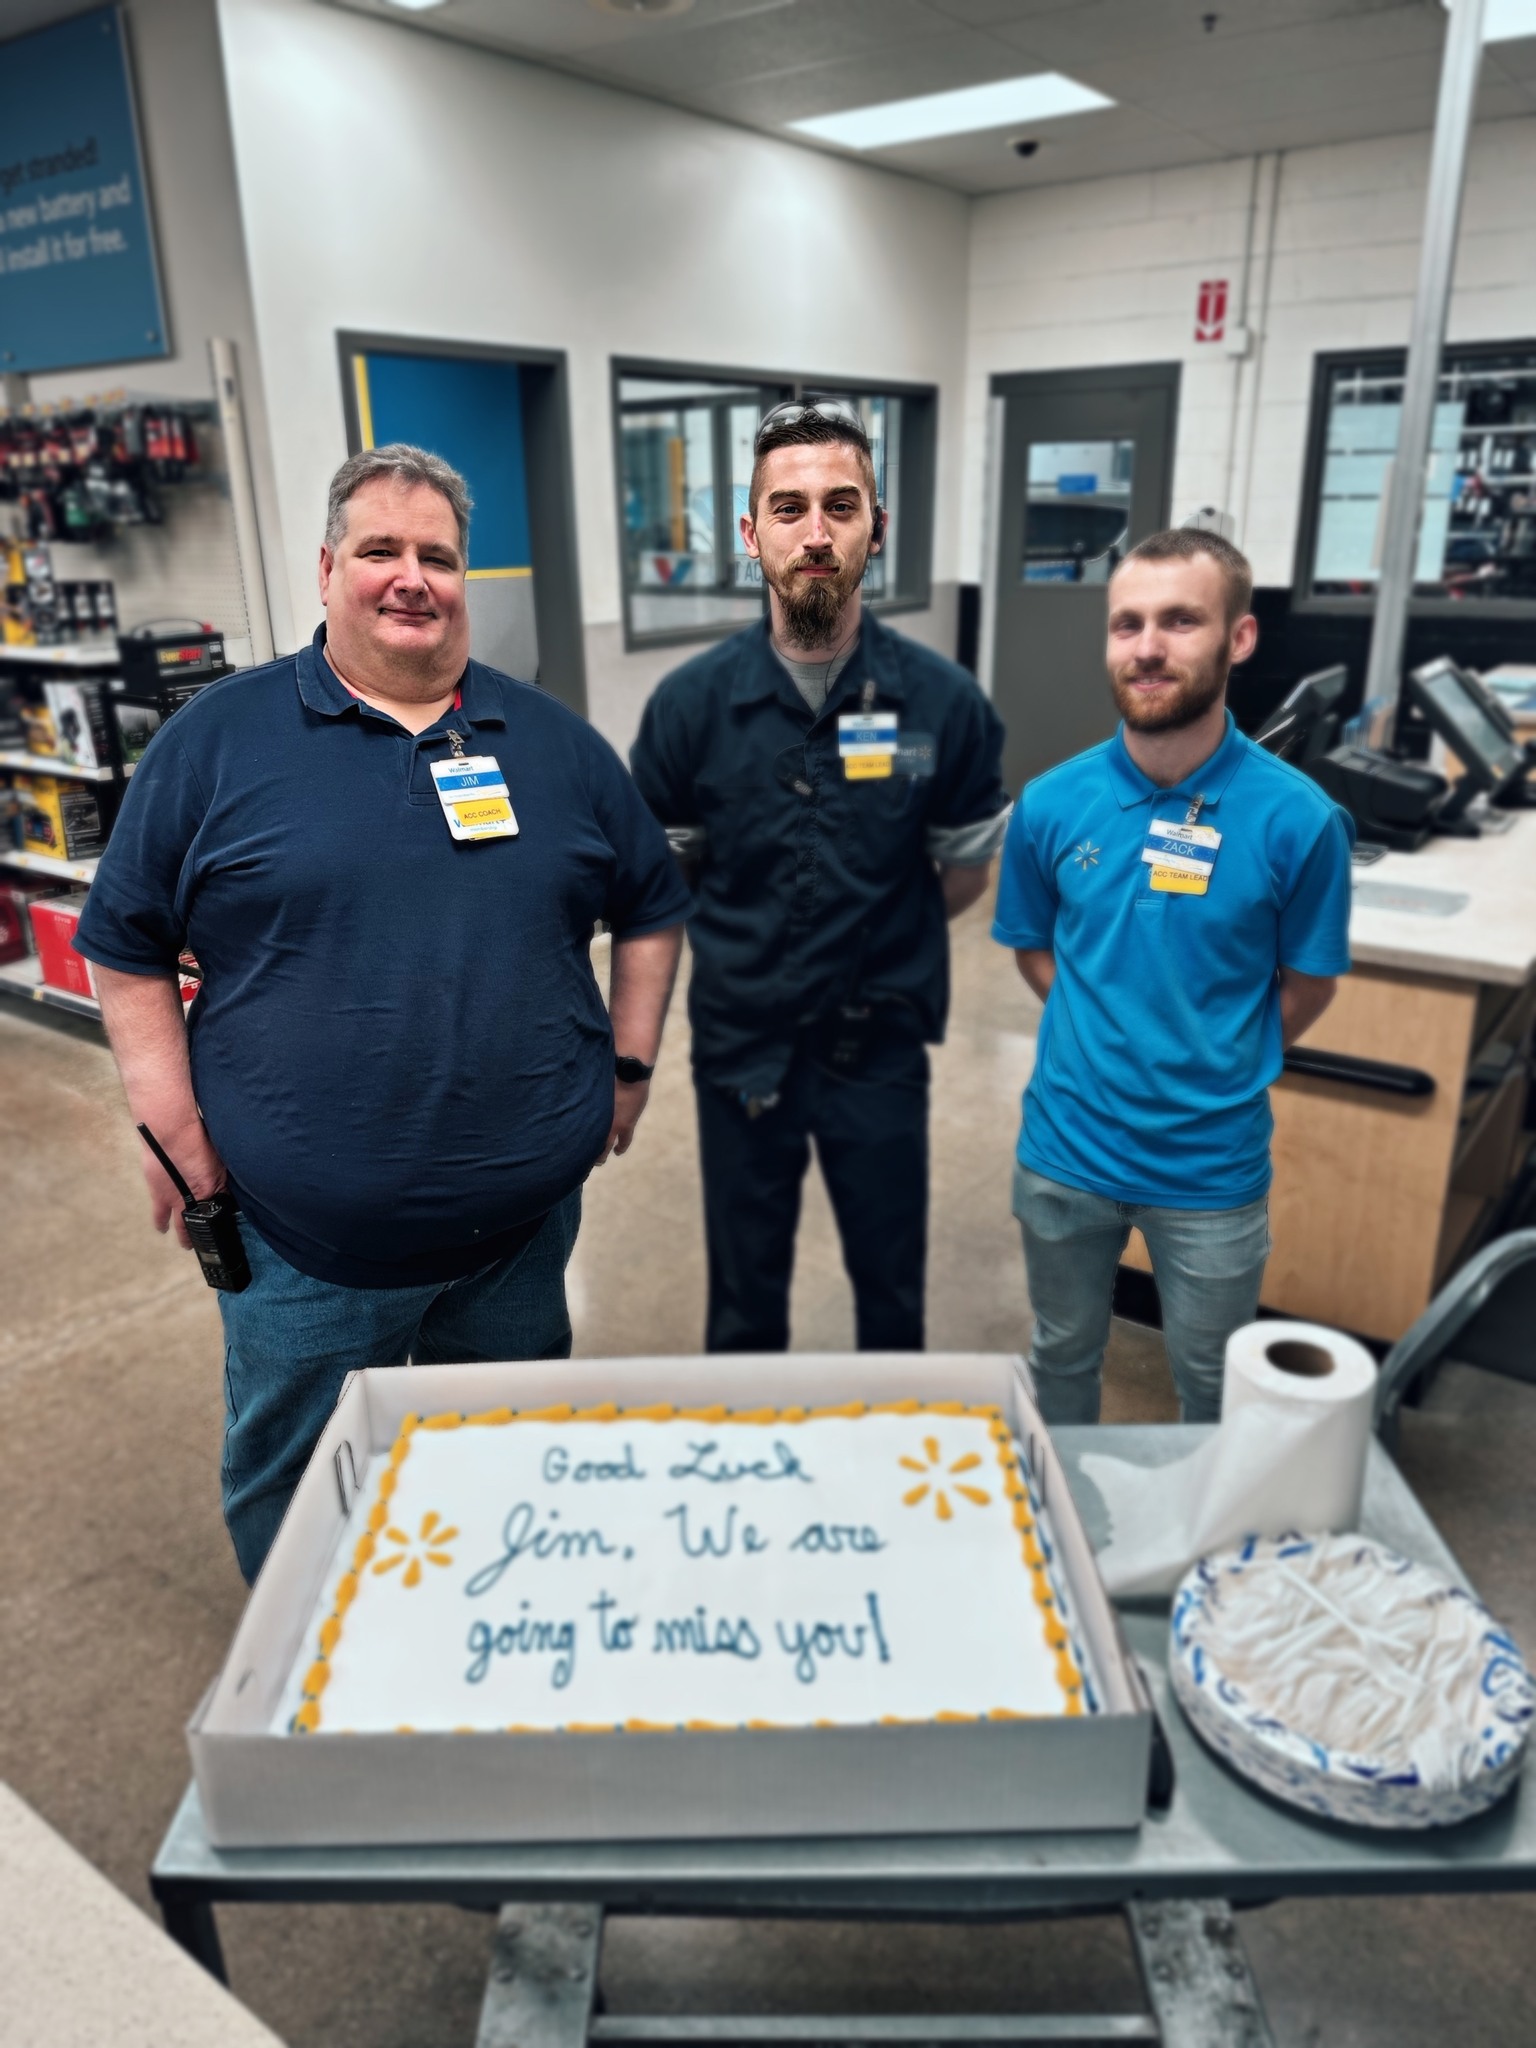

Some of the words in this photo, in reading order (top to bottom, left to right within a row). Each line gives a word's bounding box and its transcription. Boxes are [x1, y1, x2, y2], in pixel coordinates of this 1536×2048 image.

[38, 193, 96, 222] battery
[99, 172, 131, 210] and
[8, 236, 49, 272] install
[63, 230, 87, 260] for
[856, 731, 877, 742] KEN
[460, 776, 480, 787] JIM
[478, 809, 501, 817] COACH
[1166, 829, 1193, 840] Walmart
[1162, 840, 1196, 856] ZACK
[1190, 873, 1208, 882] LEAD
[542, 1441, 647, 1483] Good
[668, 1440, 814, 1483] Luck
[664, 1503, 768, 1558] We
[789, 1522, 887, 1554] are
[465, 1600, 576, 1690] going
[588, 1590, 639, 1651] to
[653, 1606, 762, 1659] miss
[776, 1591, 890, 1684] you!
